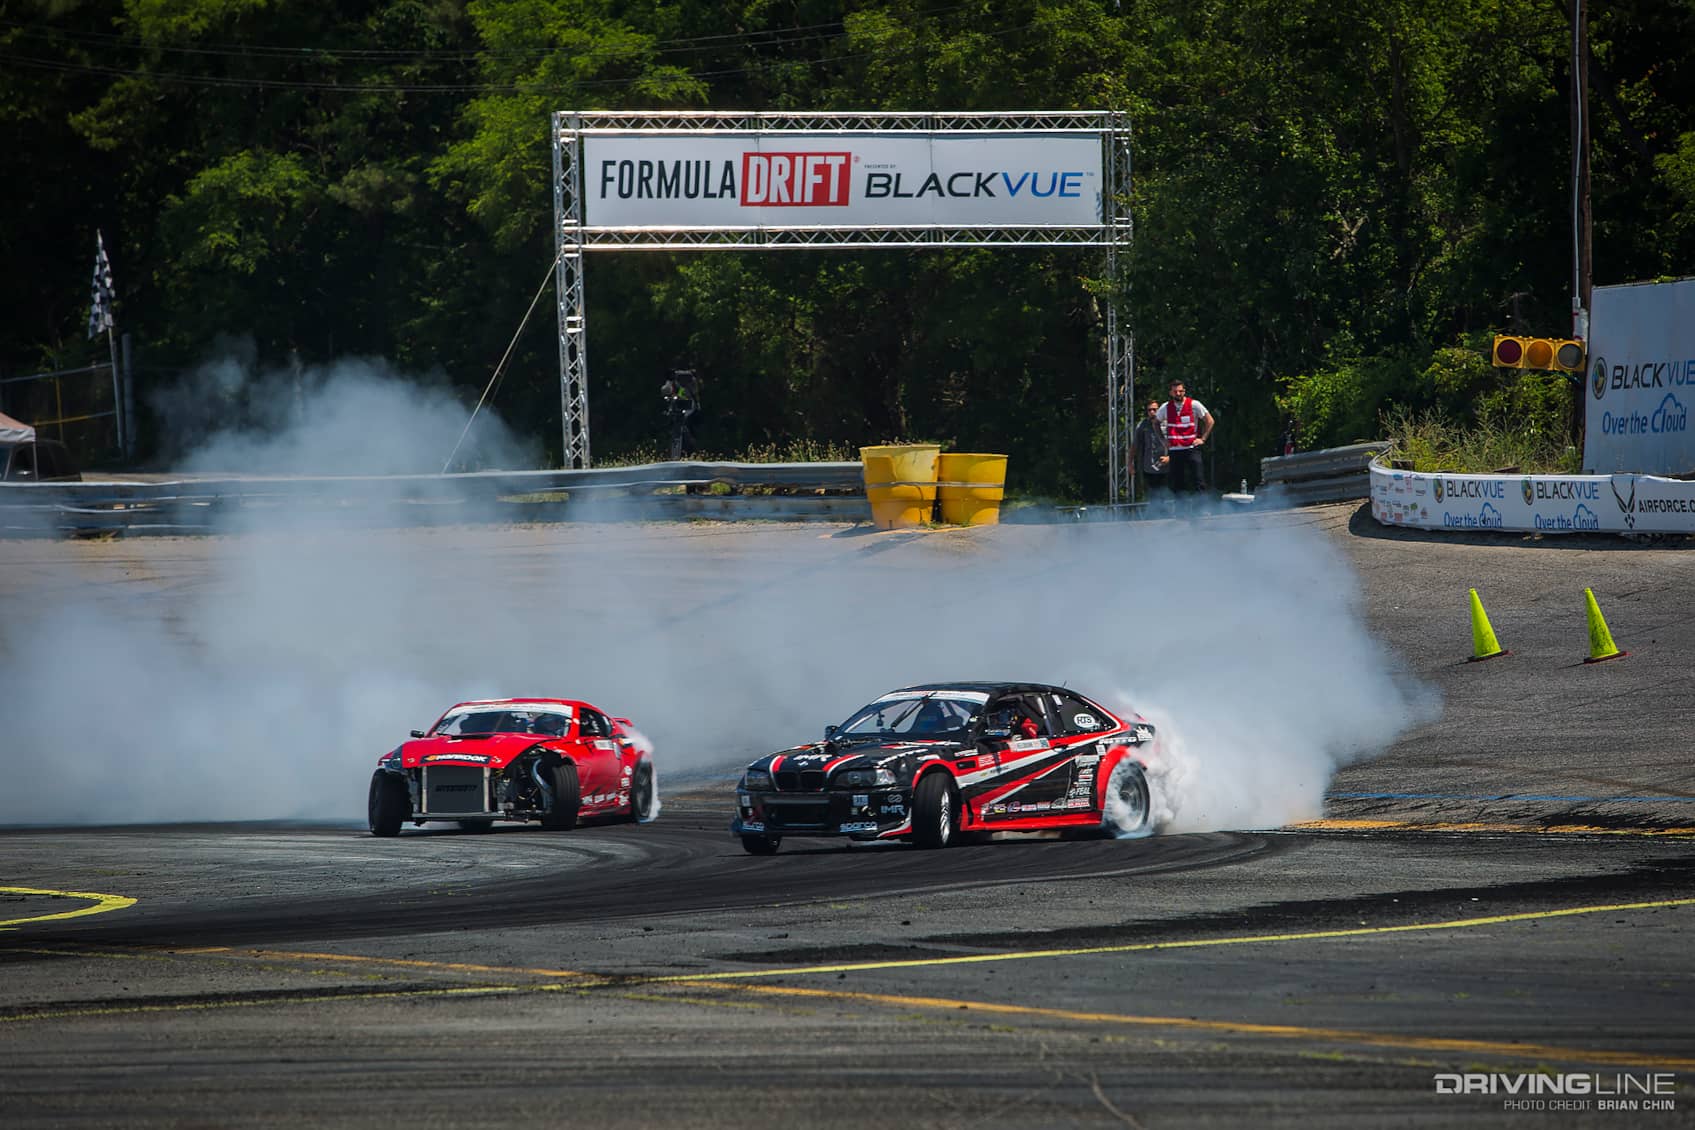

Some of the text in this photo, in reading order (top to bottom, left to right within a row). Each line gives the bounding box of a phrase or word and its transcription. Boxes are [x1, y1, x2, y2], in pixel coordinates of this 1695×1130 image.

[600, 155, 846, 203] FORMULA DRIFT
[864, 172, 1084, 198] BLACKVUE
[1611, 360, 1695, 390] BLACKVUE
[1602, 407, 1687, 435] Over the Cloud
[1447, 480, 1504, 498] BLACKVUE
[1536, 481, 1600, 499] BLACKVUE
[1444, 512, 1463, 528] Over
[1464, 512, 1478, 528] the
[1535, 513, 1599, 530] Over the Cloud
